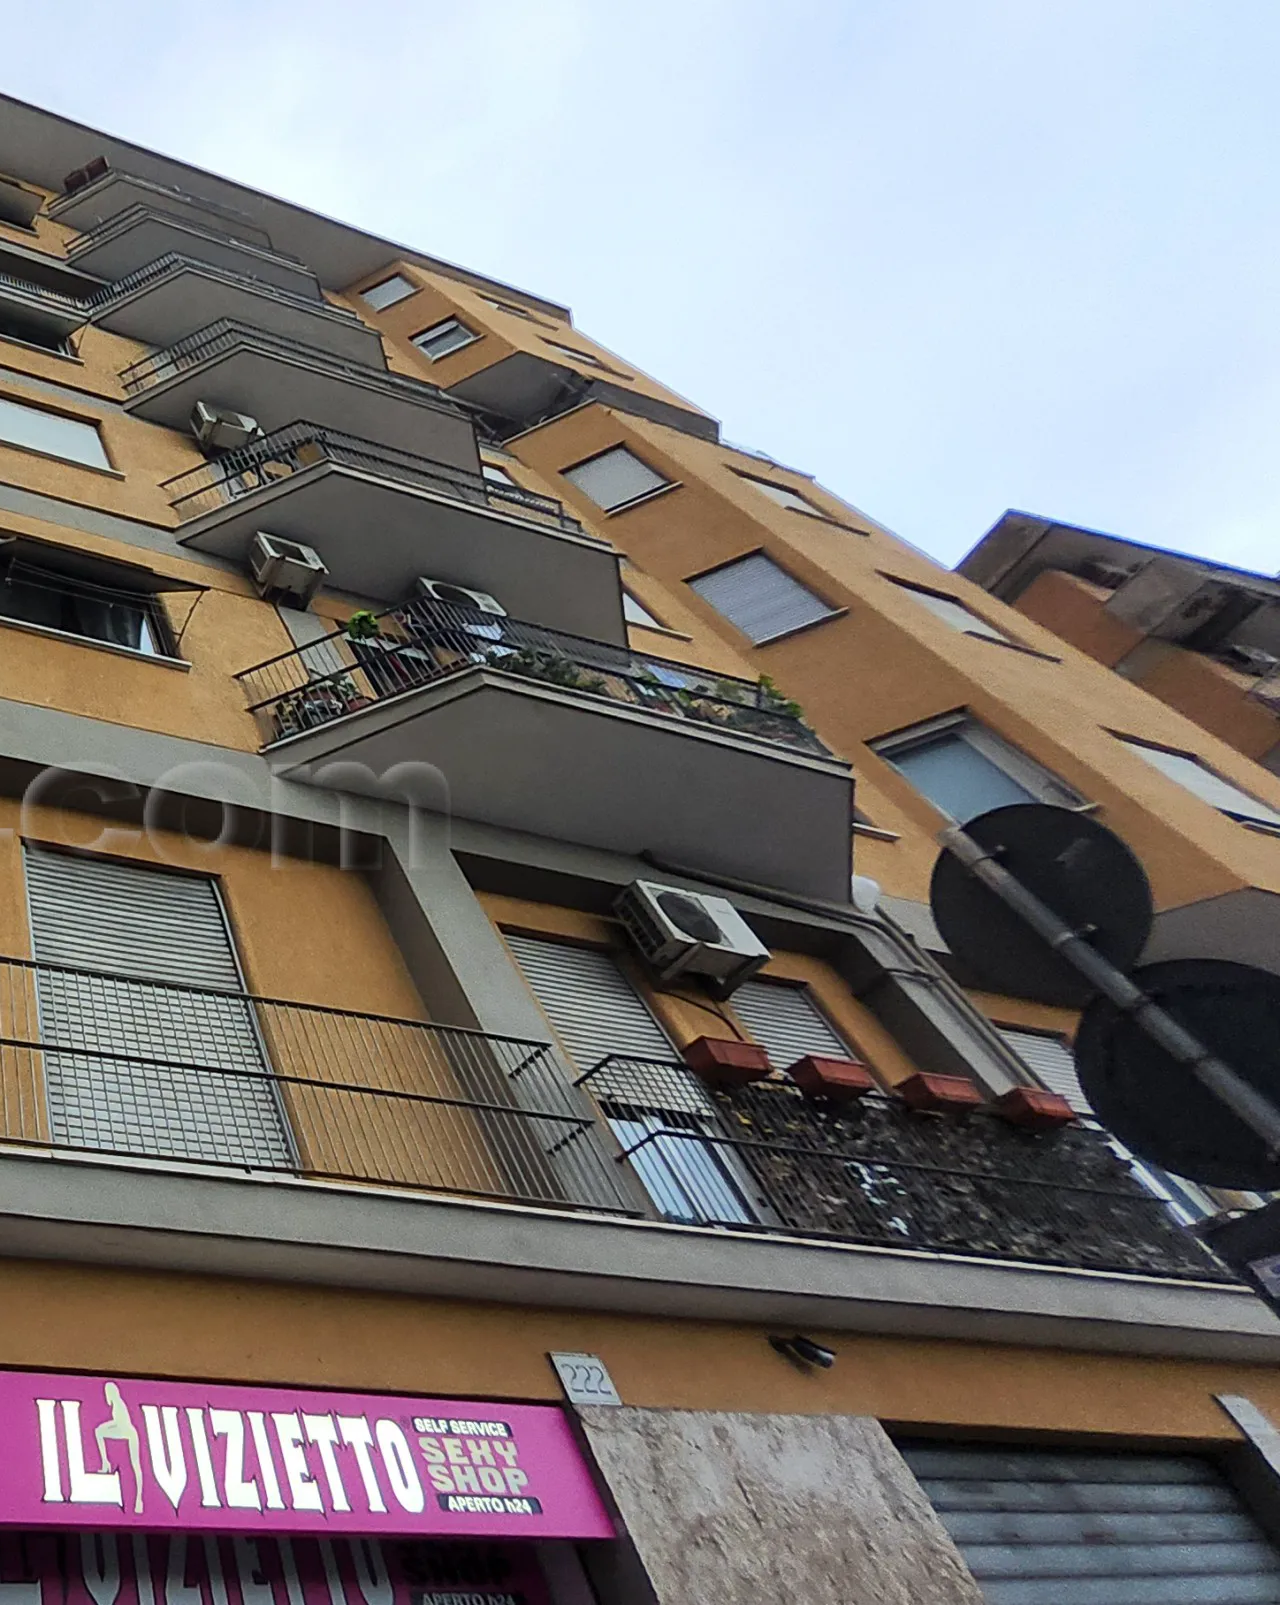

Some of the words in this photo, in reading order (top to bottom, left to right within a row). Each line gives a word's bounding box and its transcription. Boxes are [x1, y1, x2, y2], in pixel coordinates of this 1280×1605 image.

[561, 1363, 612, 1396] 222
[413, 1417, 449, 1433] SELF
[449, 1420, 509, 1438] SERVICE
[35, 1398, 124, 1512] IL
[140, 1402, 424, 1519] VIZIETTO
[418, 1437, 518, 1467] SEXY
[427, 1464, 529, 1495] SHOP
[448, 1495, 506, 1513] APERTO
[503, 1498, 533, 1515] h24
